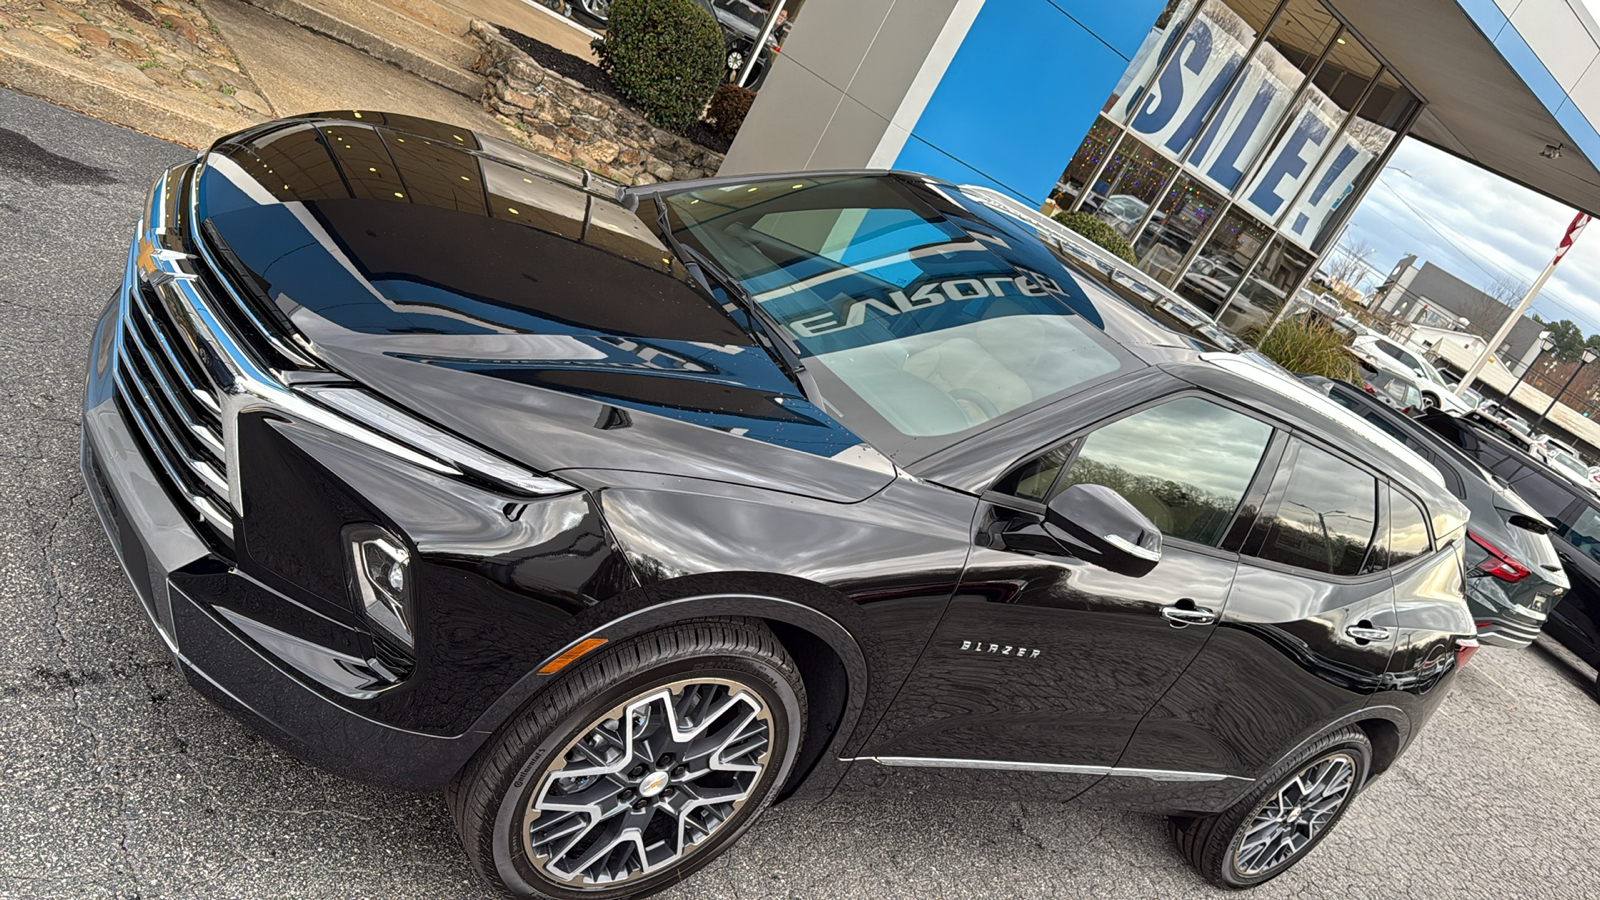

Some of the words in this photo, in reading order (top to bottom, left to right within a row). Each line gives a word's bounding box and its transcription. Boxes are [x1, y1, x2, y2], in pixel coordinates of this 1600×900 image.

[1125, 17, 1359, 236] SALE!
[960, 640, 1041, 658] BLAZER
[513, 752, 542, 788] Continental
